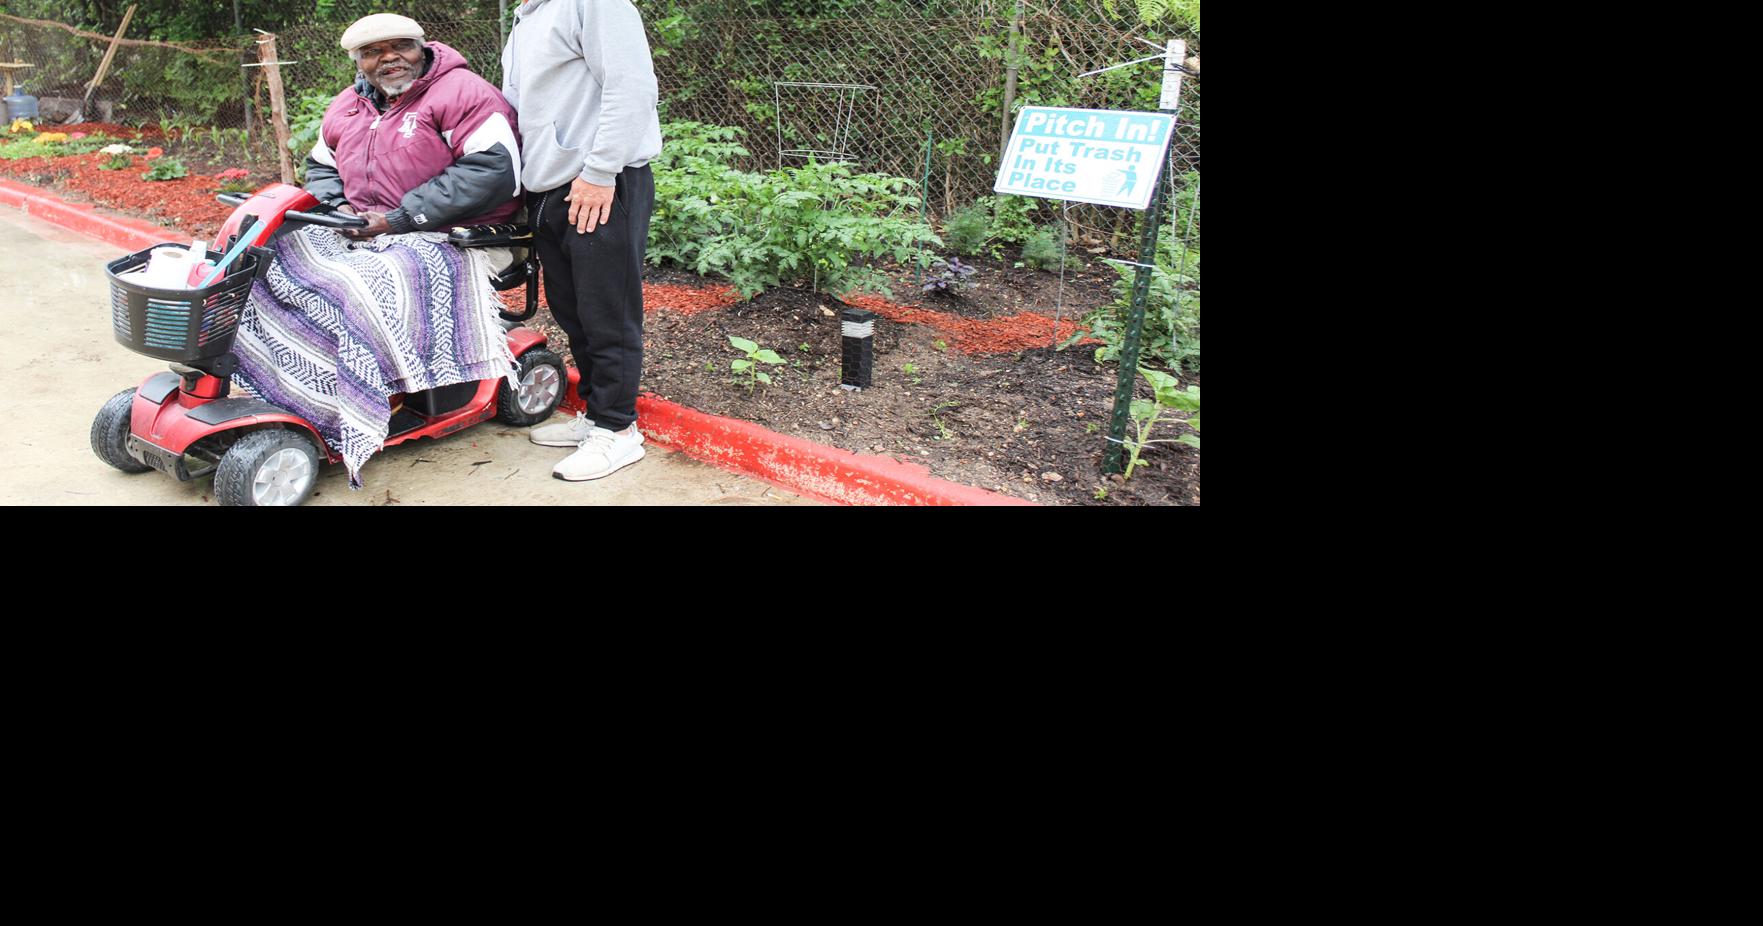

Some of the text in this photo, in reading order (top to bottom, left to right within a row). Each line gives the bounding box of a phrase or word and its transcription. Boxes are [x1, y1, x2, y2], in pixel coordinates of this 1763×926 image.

[1024, 112, 1162, 142] Pitch In!
[1019, 138, 1142, 162] Put Trash
[1013, 154, 1076, 174] In Its
[1008, 171, 1076, 193] Place
